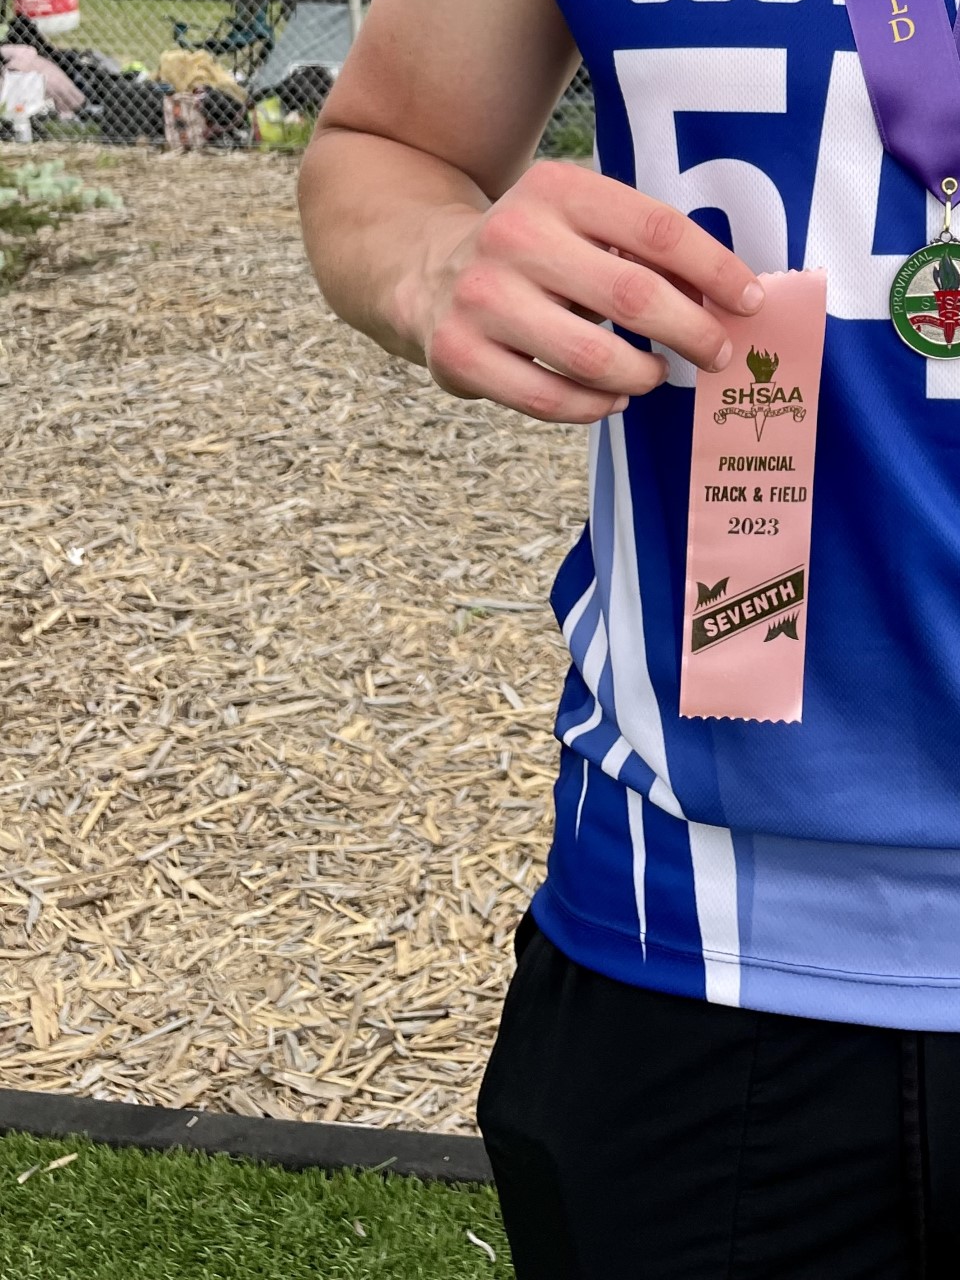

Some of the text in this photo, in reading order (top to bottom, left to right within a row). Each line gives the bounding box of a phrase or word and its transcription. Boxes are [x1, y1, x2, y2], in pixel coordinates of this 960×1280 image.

[721, 386, 804, 405] SHSAA
[718, 455, 796, 473] PROVINCIAL
[704, 485, 807, 503] TRACK & FIELD
[727, 516, 780, 537] 2023
[703, 580, 796, 638] SEVENTH
